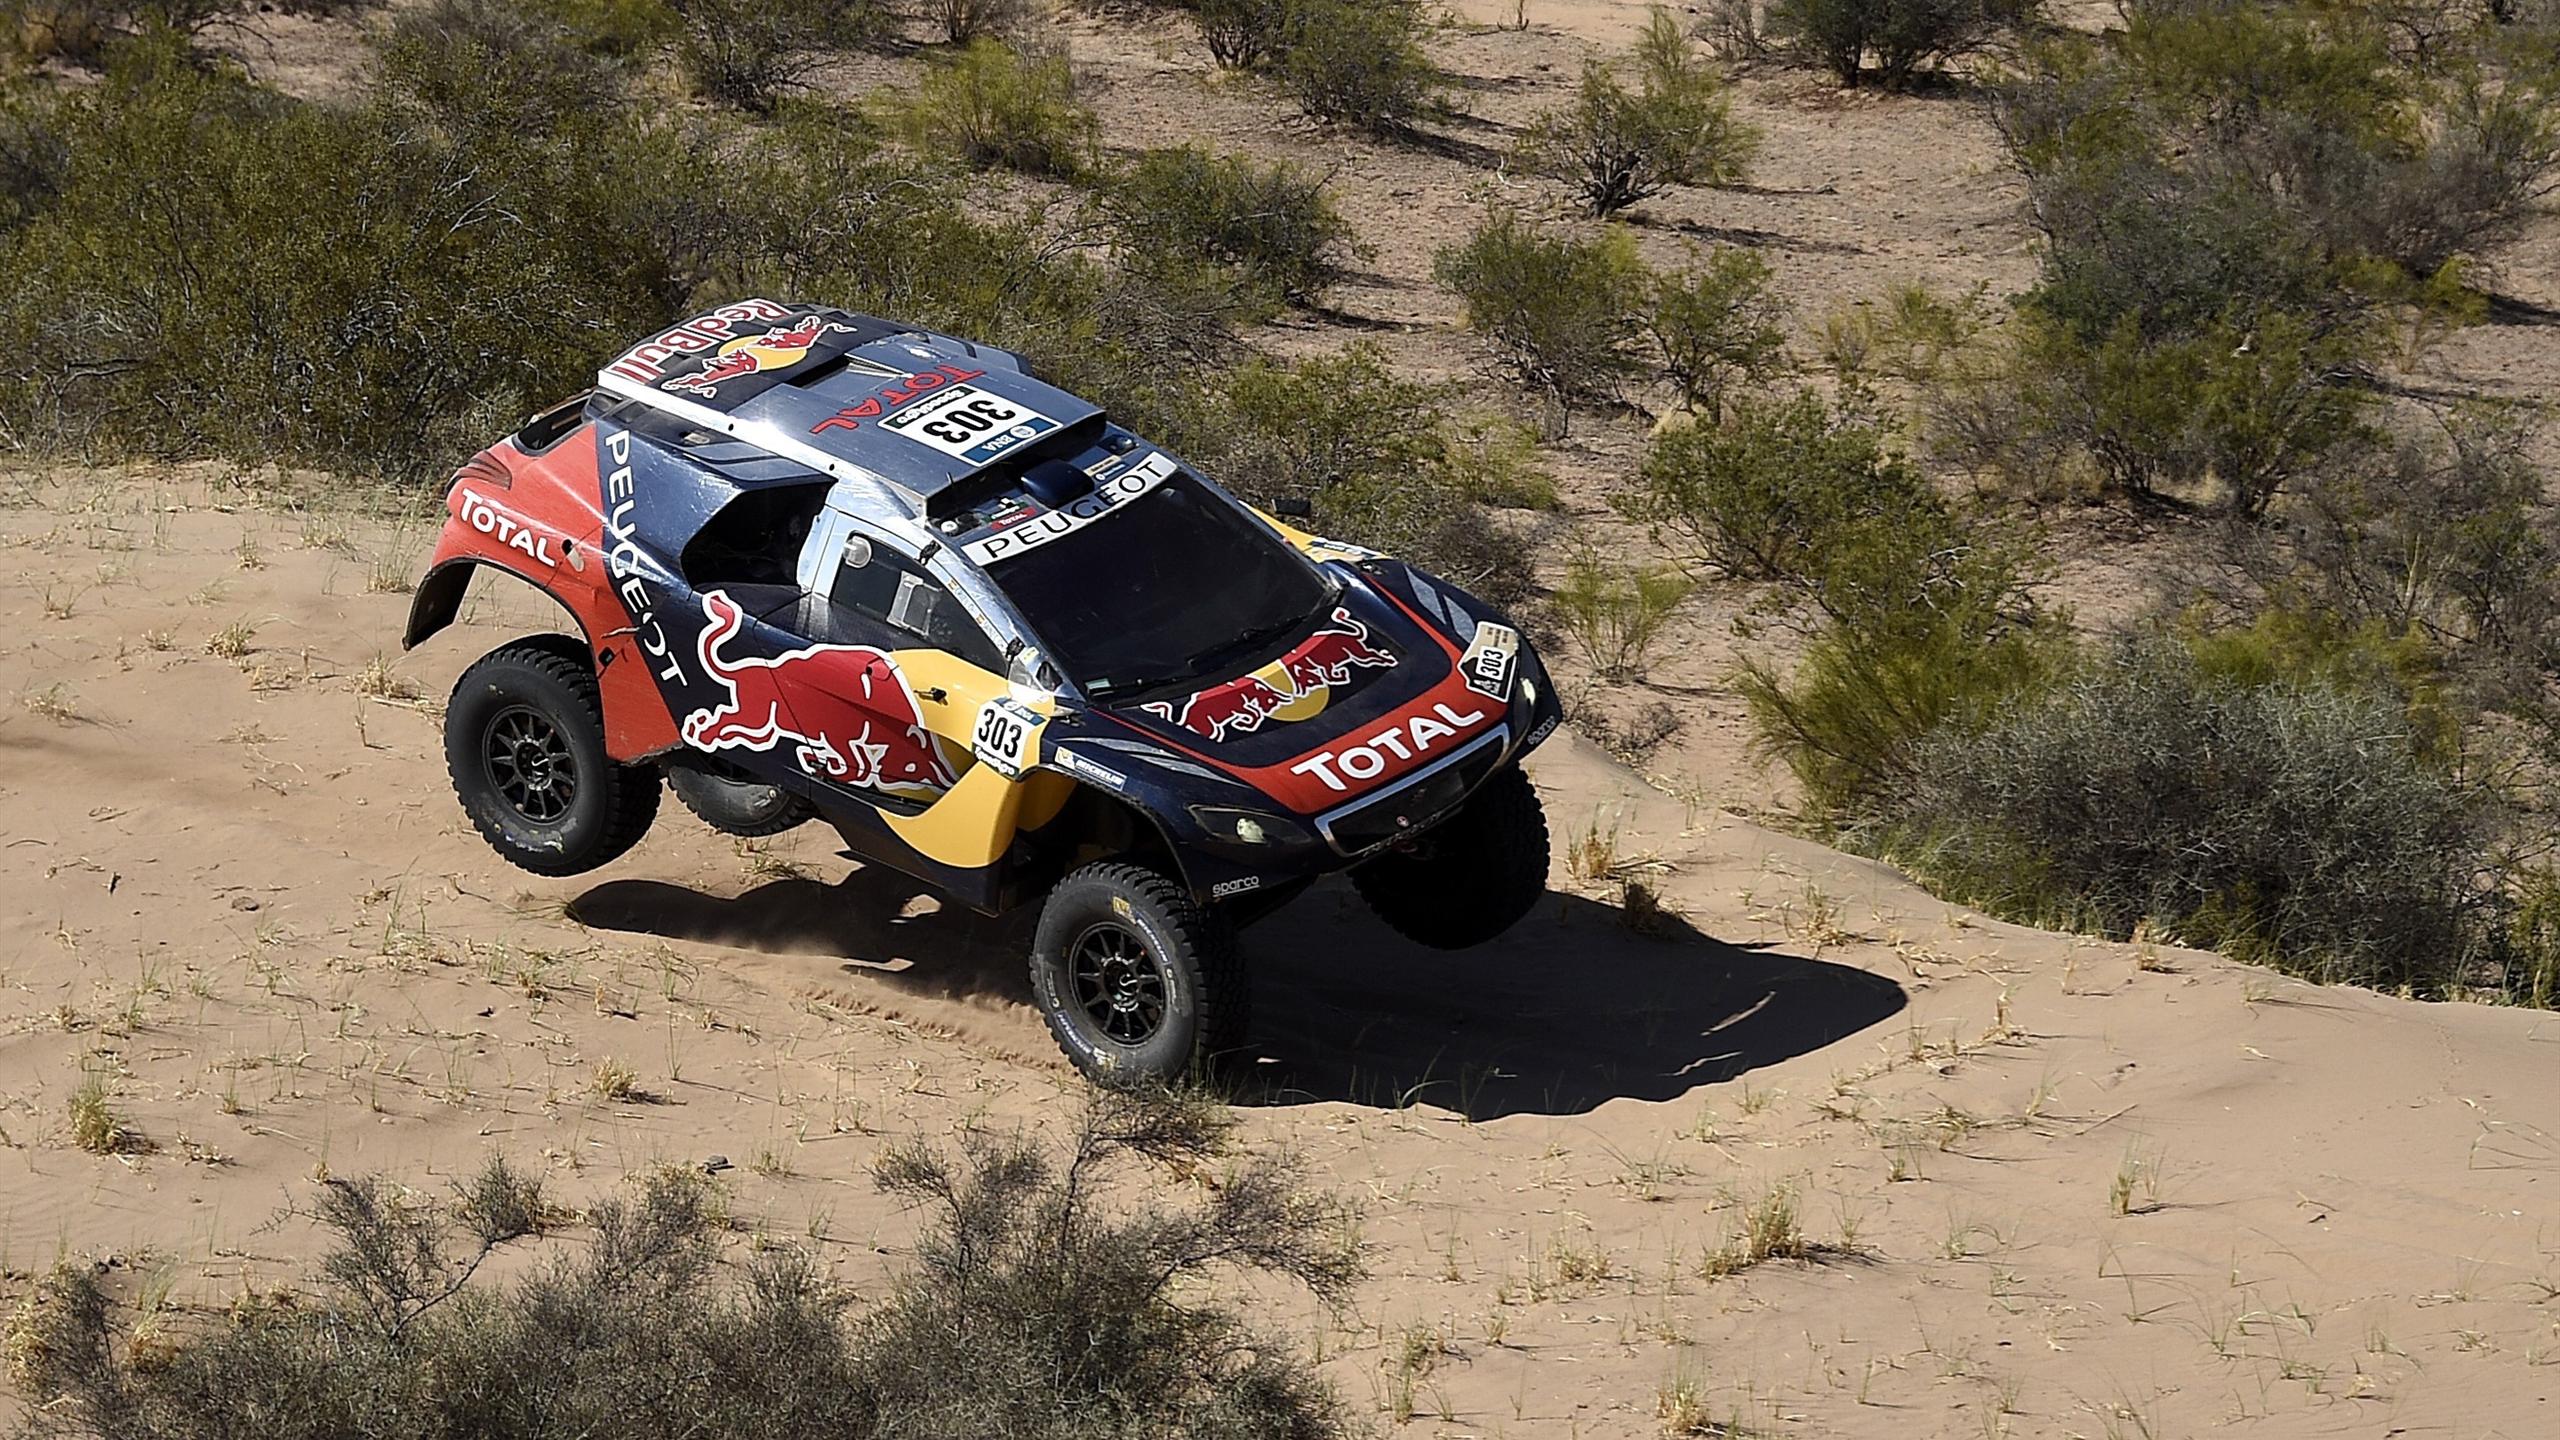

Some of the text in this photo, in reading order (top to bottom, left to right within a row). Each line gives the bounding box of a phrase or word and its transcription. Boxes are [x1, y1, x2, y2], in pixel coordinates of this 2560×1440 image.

[607, 299, 793, 385] Red Bull
[809, 364, 987, 434] TOTAL
[922, 400, 1016, 443] 303
[460, 488, 555, 567] TOTAL
[982, 461, 1167, 558] PEUGEOT
[999, 512, 1028, 526] TOTAL
[605, 429, 688, 687] PEUGEOT
[1480, 650, 1503, 676] 303
[978, 708, 1022, 758] 303
[1290, 703, 1485, 791] TOTAL
[1212, 875, 1260, 896] sparco
